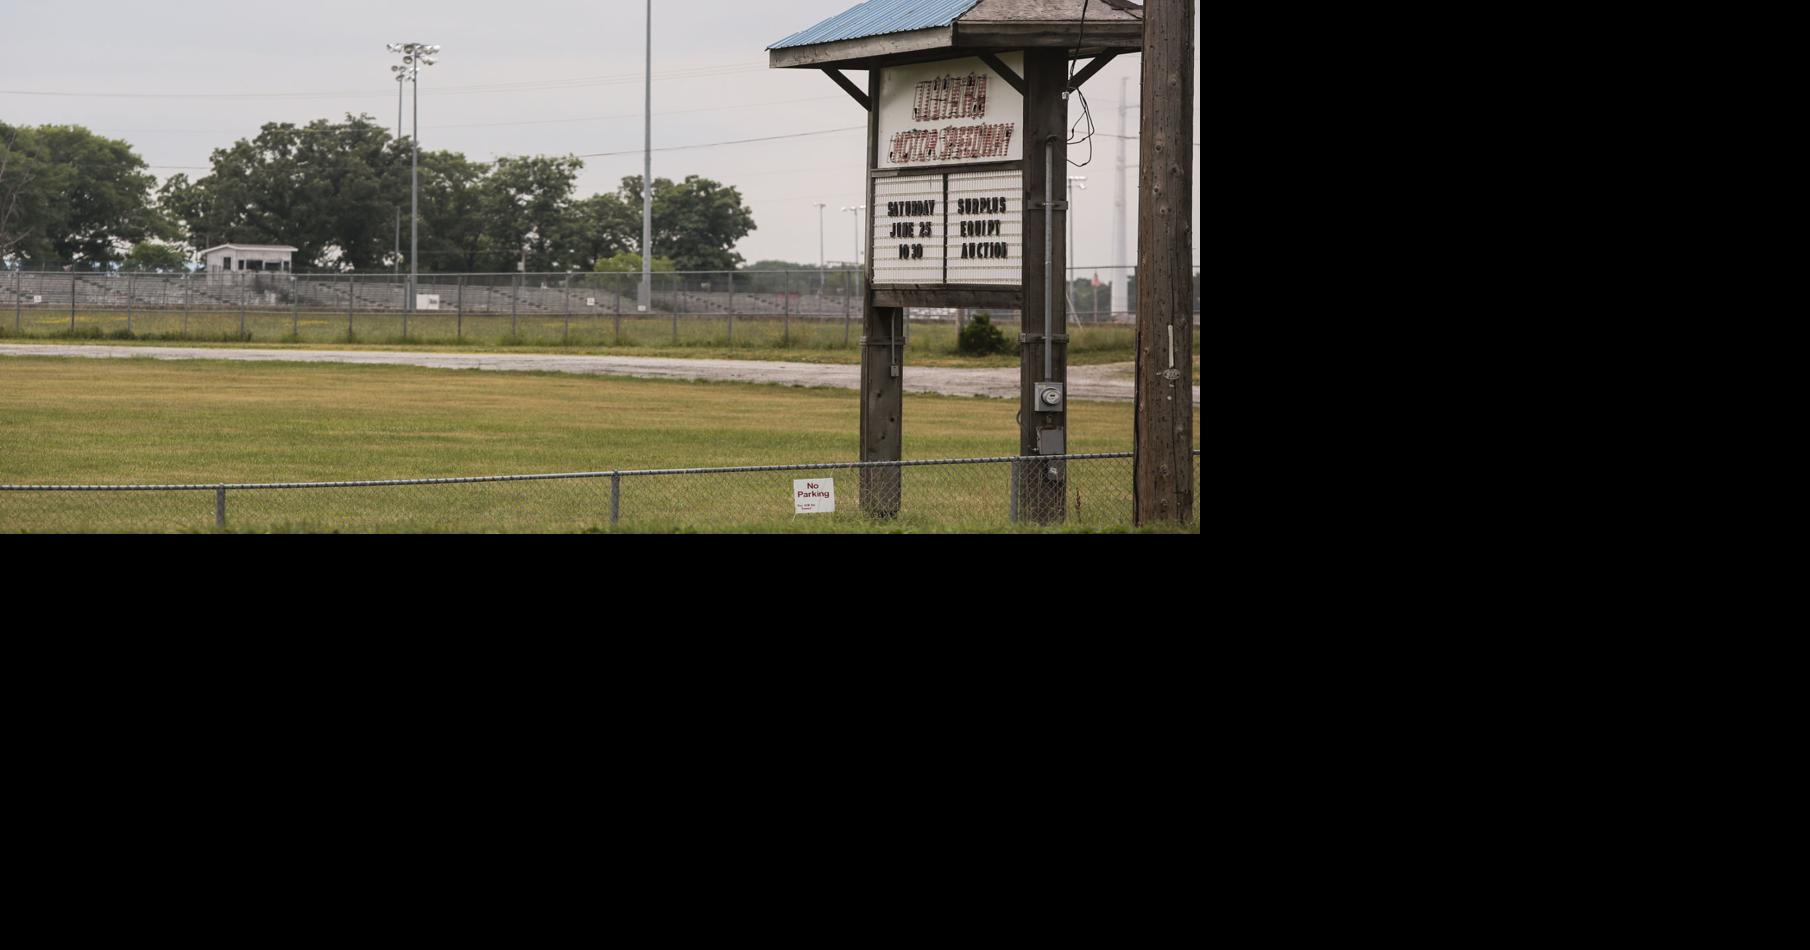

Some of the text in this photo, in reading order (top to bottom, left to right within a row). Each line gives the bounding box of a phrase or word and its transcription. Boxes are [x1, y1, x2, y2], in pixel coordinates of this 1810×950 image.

[938, 122, 1015, 160] SPEEDWAY
[887, 199, 935, 216] SATURDAY
[957, 196, 1007, 215] SURPLUS
[889, 221, 915, 239] JUNE
[960, 219, 1001, 238] EQUIPT
[960, 241, 1009, 260] AUCTION
[797, 491, 830, 499] Parking
